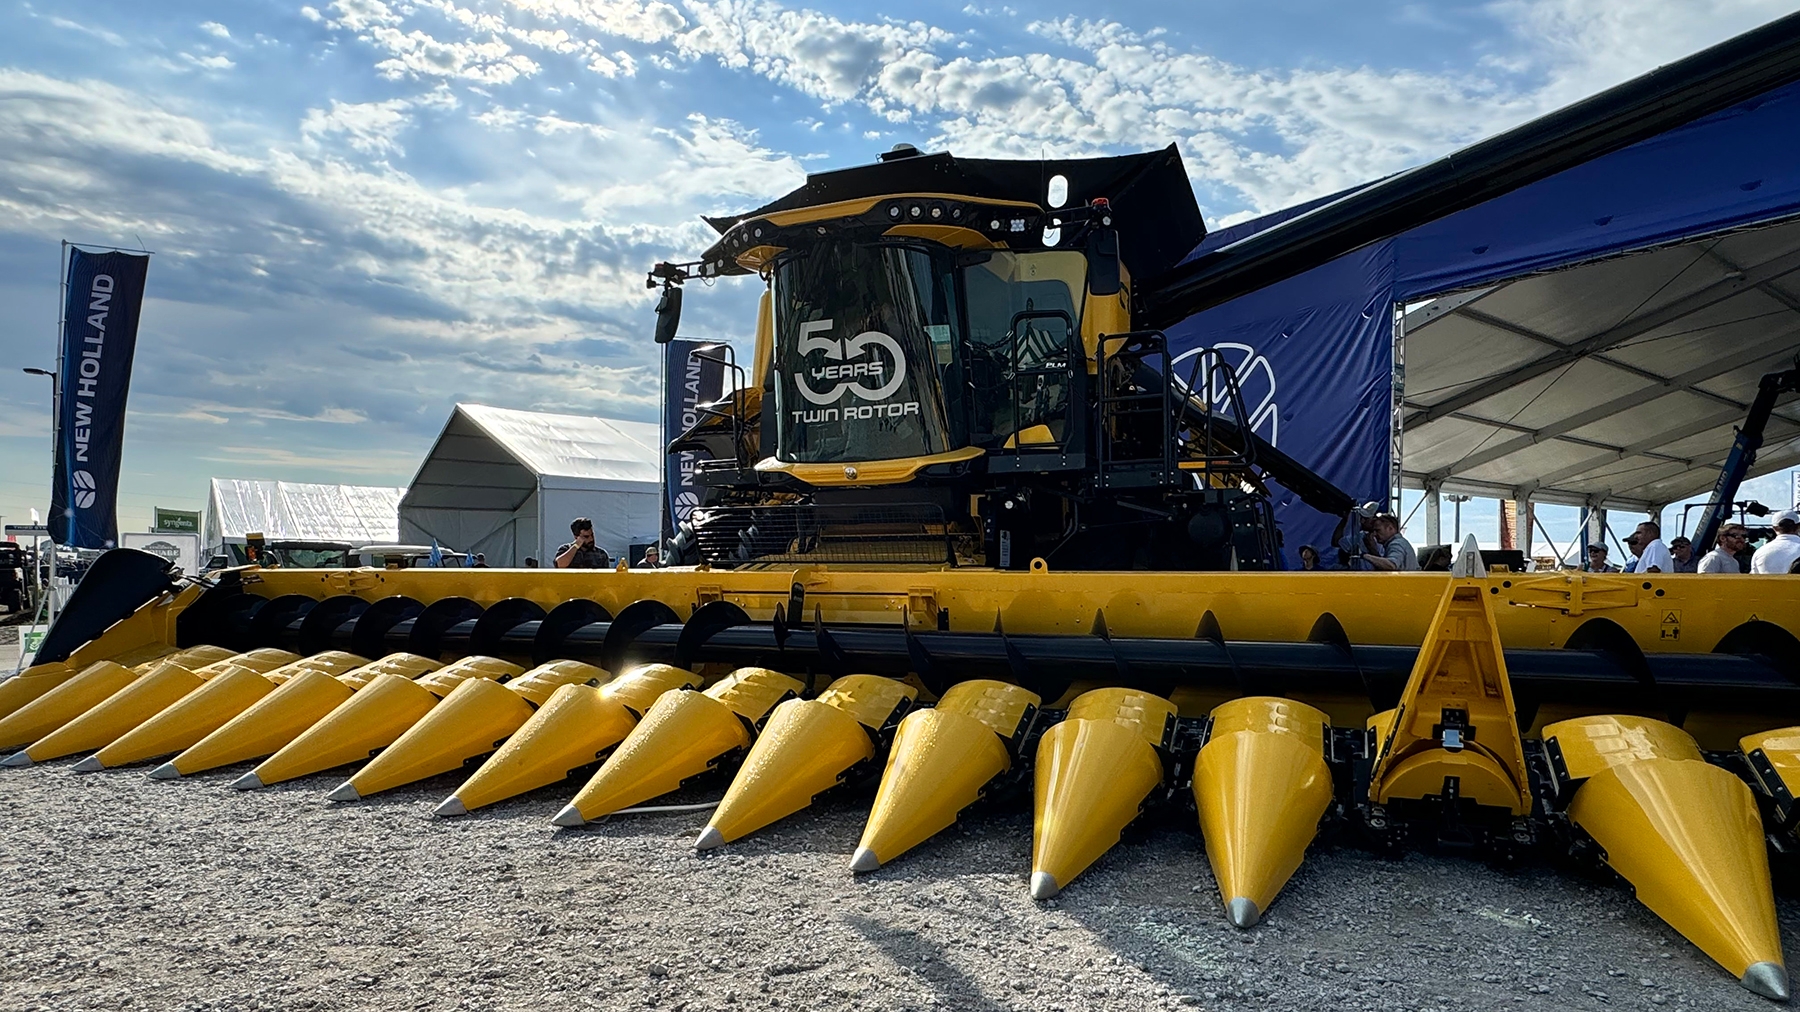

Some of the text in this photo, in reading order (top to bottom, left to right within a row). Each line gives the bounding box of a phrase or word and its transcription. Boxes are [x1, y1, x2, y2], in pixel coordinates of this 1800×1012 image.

[75, 274, 114, 462] NEW HOLLAND
[794, 319, 906, 405] 50
[811, 361, 884, 380] YEARS
[792, 401, 919, 424] TWIN ROTOR
[163, 517, 193, 528] syngenta
